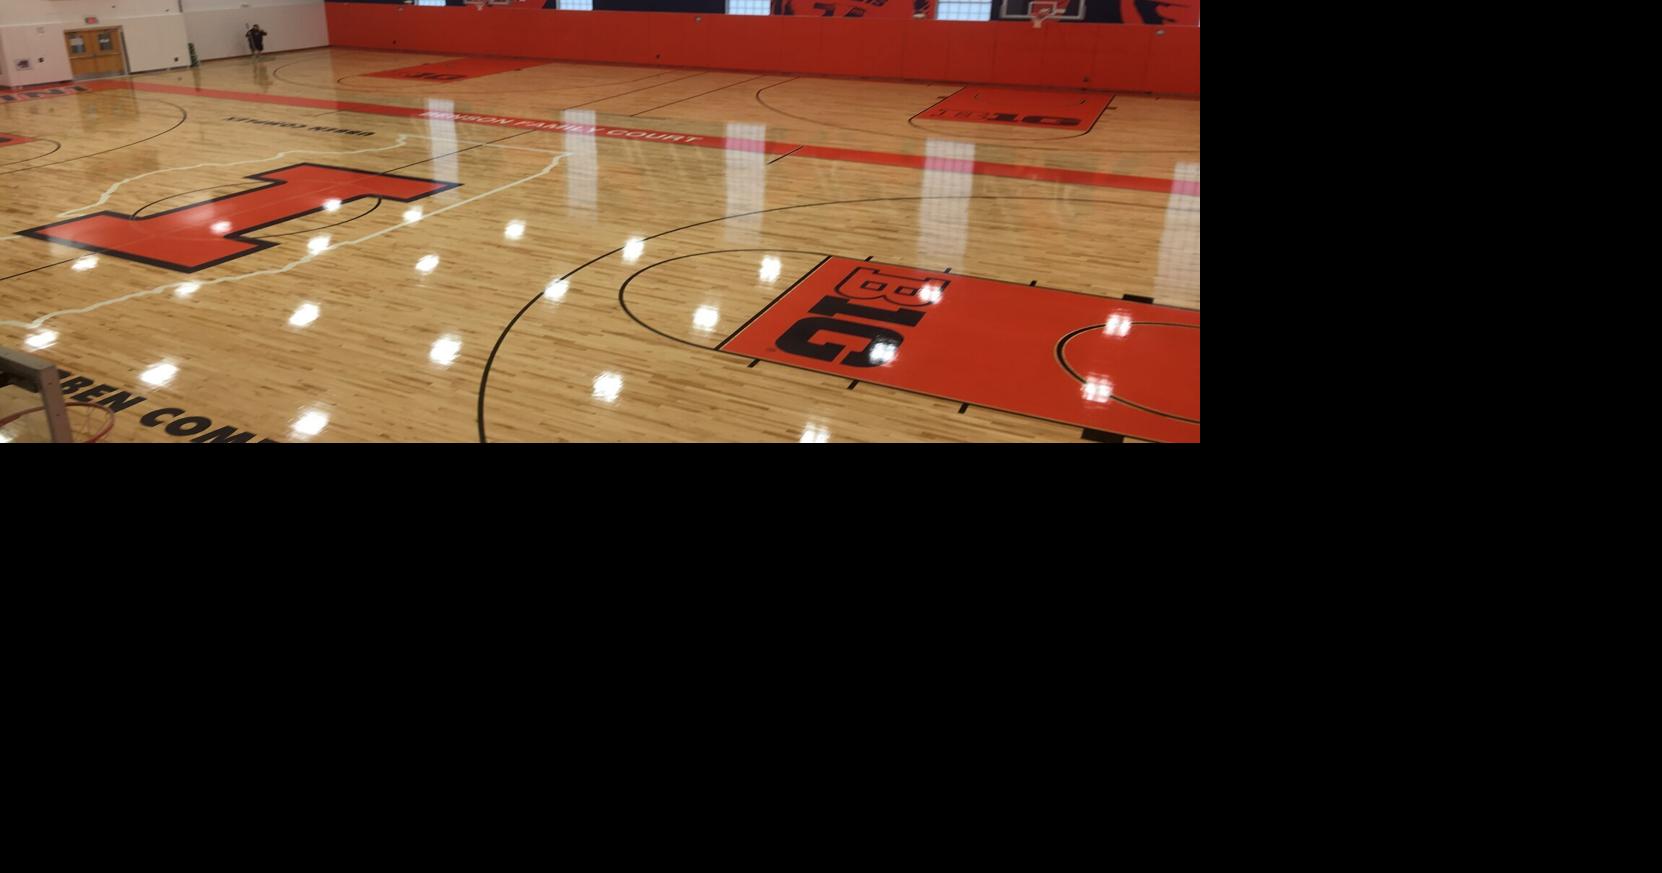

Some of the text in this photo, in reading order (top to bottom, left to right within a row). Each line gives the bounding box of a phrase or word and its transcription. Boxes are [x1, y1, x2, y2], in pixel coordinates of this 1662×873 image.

[418, 111, 704, 143] BENSON FAMILY COURT
[57, 368, 281, 443] BEN COM
